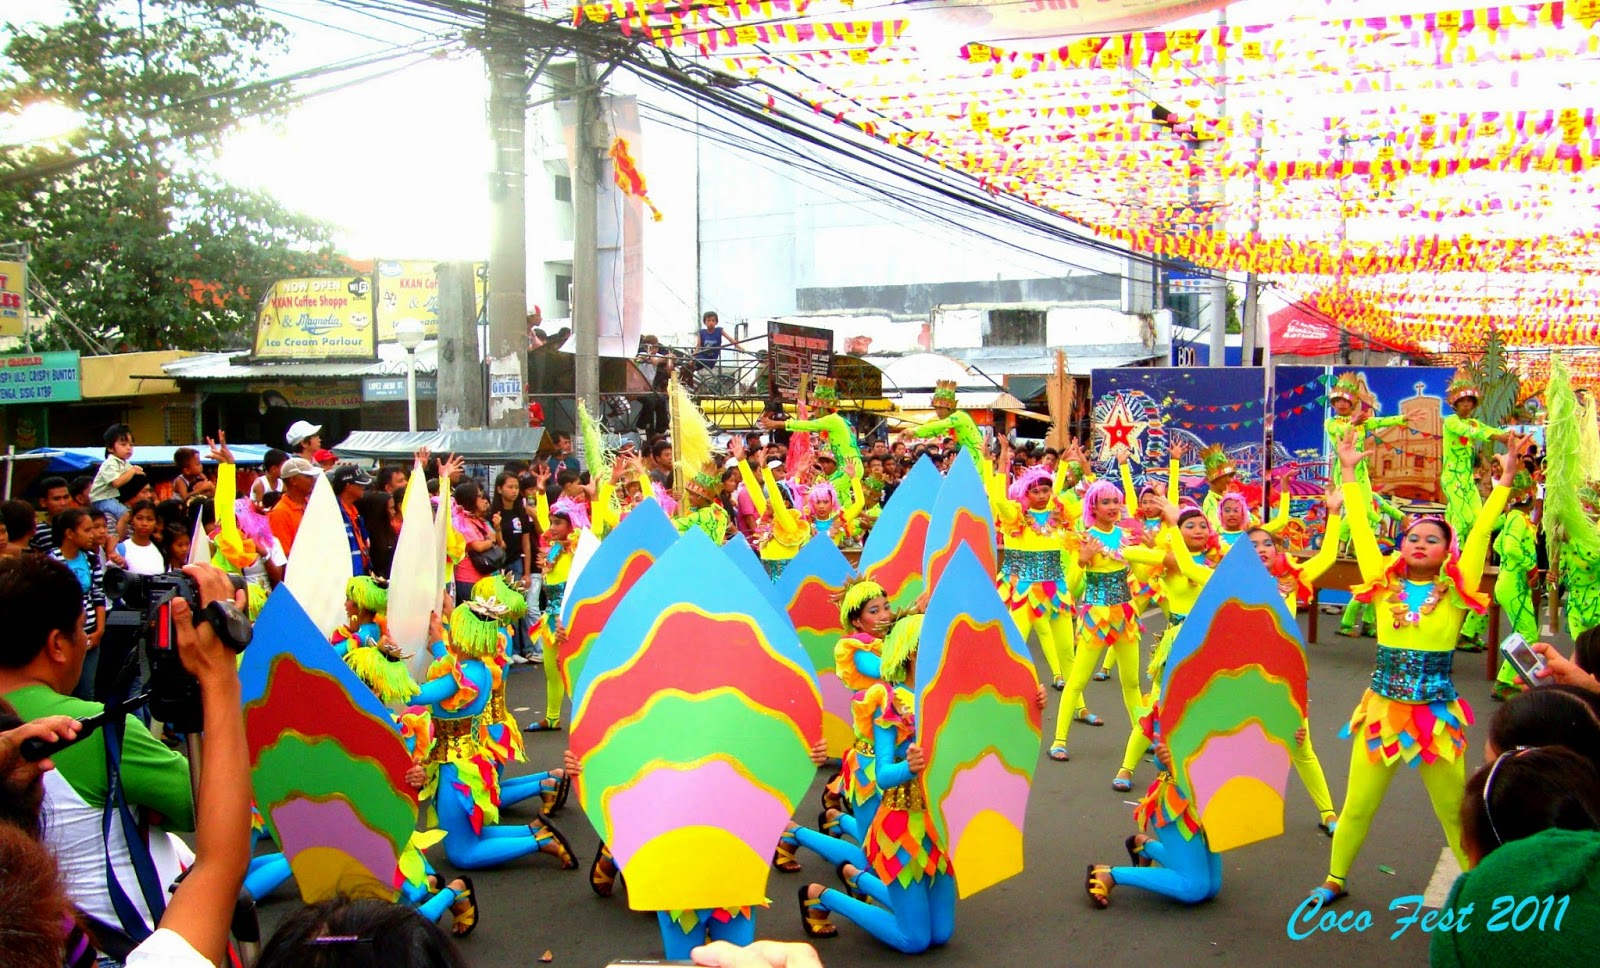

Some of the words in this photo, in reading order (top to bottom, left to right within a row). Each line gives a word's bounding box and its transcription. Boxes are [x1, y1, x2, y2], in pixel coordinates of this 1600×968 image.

[283, 281, 309, 292] NOW
[312, 280, 342, 291] OPEN
[400, 279, 422, 289] KKAN
[271, 297, 293, 308] KKAN
[294, 297, 318, 308] Coffee
[320, 296, 348, 309] Shoppe
[282, 315, 293, 328] &
[295, 313, 343, 331] Magnolia
[266, 339, 281, 347] Ice
[284, 338, 318, 347] Cream
[322, 337, 363, 346] Parlour
[1177, 346, 1196, 367] BDO
[29, 369, 50, 381] CRISPY
[492, 382, 521, 393] ORTIZ
